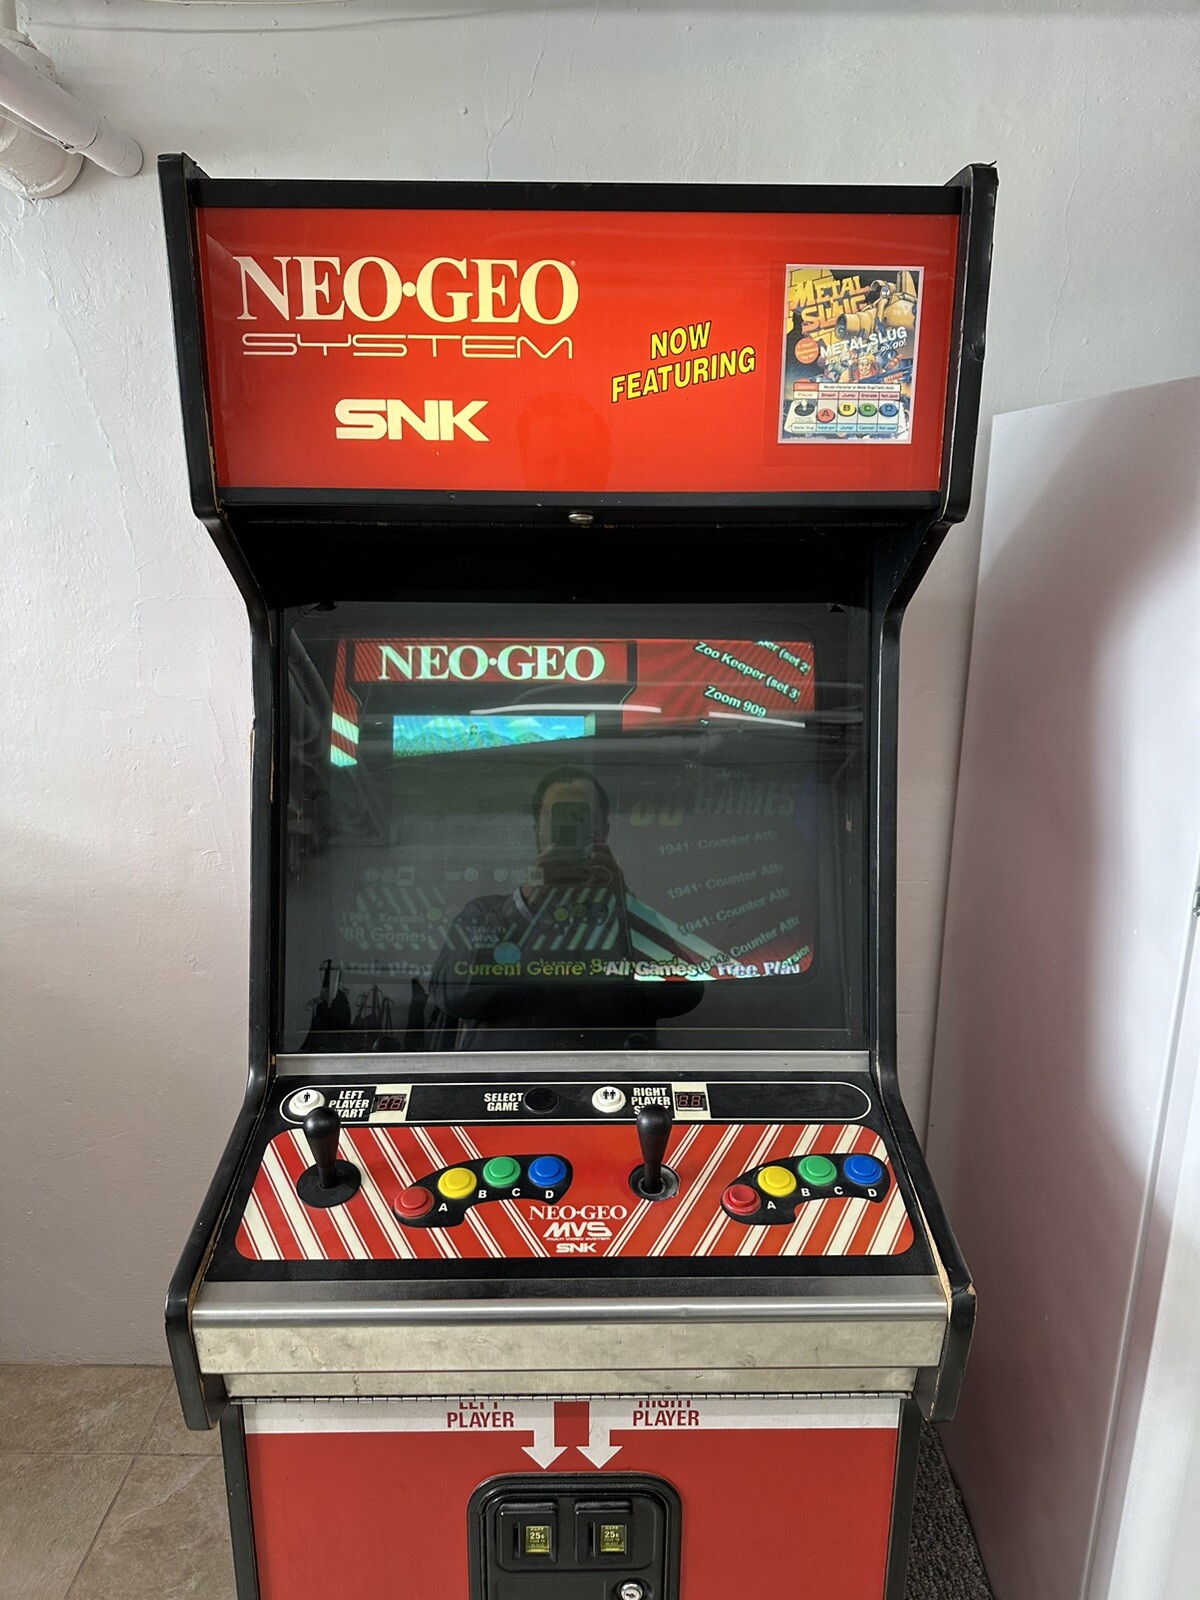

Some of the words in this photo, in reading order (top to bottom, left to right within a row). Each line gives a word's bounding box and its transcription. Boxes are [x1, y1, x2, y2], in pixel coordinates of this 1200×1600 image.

[788, 275, 870, 310] METAL
[650, 320, 712, 360] NOW
[868, 326, 908, 346] SLUG
[242, 333, 573, 359] SYSTEM
[611, 345, 756, 403] FEATURING
[334, 398, 490, 442] SNK
[779, 648, 800, 667] (set
[694, 641, 720, 660] Zoo
[721, 652, 766, 682] Keeper
[766, 675, 789, 695] (set
[704, 685, 741, 709] Zoom
[742, 702, 767, 718] 909
[698, 834, 749, 850] Counter
[705, 870, 756, 890] Counter
[716, 897, 766, 922] Counter
[730, 927, 777, 957] Counter
[453, 961, 522, 976] Current
[527, 961, 583, 976] Genre
[606, 960, 631, 976] All
[635, 960, 698, 977] Games
[338, 1090, 365, 1100] LEFT
[484, 1092, 524, 1102] SELECT
[633, 1087, 667, 1097] RIGHT
[328, 1099, 370, 1109] PLAYER
[486, 1102, 519, 1112] GAME
[631, 1096, 671, 1106] PLAYER
[335, 1108, 366, 1118] TART
[478, 1189, 488, 1199] B
[511, 1187, 521, 1197] C
[545, 1189, 555, 1199] D
[801, 1188, 811, 1197] B
[833, 1186, 844, 1196] C
[867, 1188, 878, 1197] D
[438, 1202, 448, 1212] A
[766, 1201, 777, 1210] A
[543, 1221, 613, 1238] MVS
[556, 1243, 597, 1253] SNK
[446, 1411, 515, 1428] PLAYER
[632, 1410, 700, 1427] PLAYER
